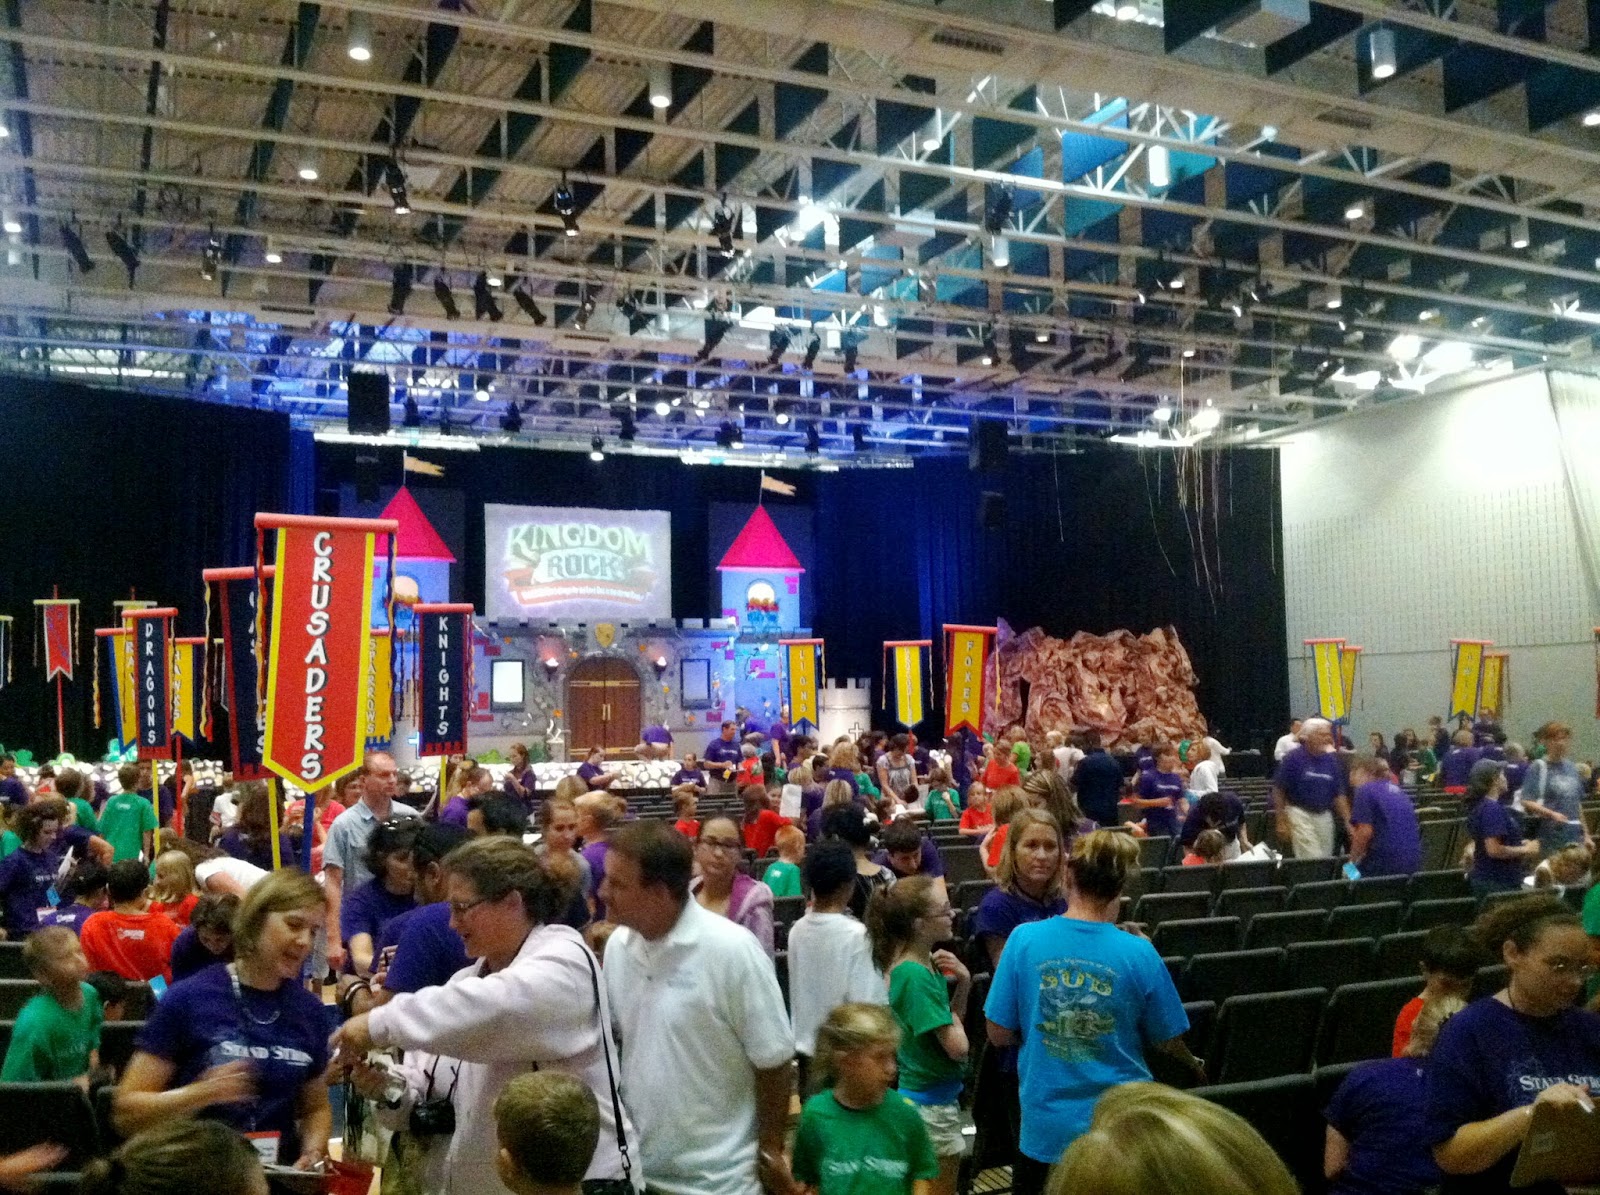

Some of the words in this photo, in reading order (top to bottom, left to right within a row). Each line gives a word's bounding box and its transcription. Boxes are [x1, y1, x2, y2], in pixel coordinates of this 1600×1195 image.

[507, 523, 650, 560] KINGDOM
[545, 552, 618, 578] ROCK
[145, 623, 156, 744] DRAGONS
[301, 531, 334, 779] CRUSADERS
[437, 616, 450, 735] KNIGHTS
[800, 649, 808, 712] LIONS
[962, 640, 974, 713] FOXES
